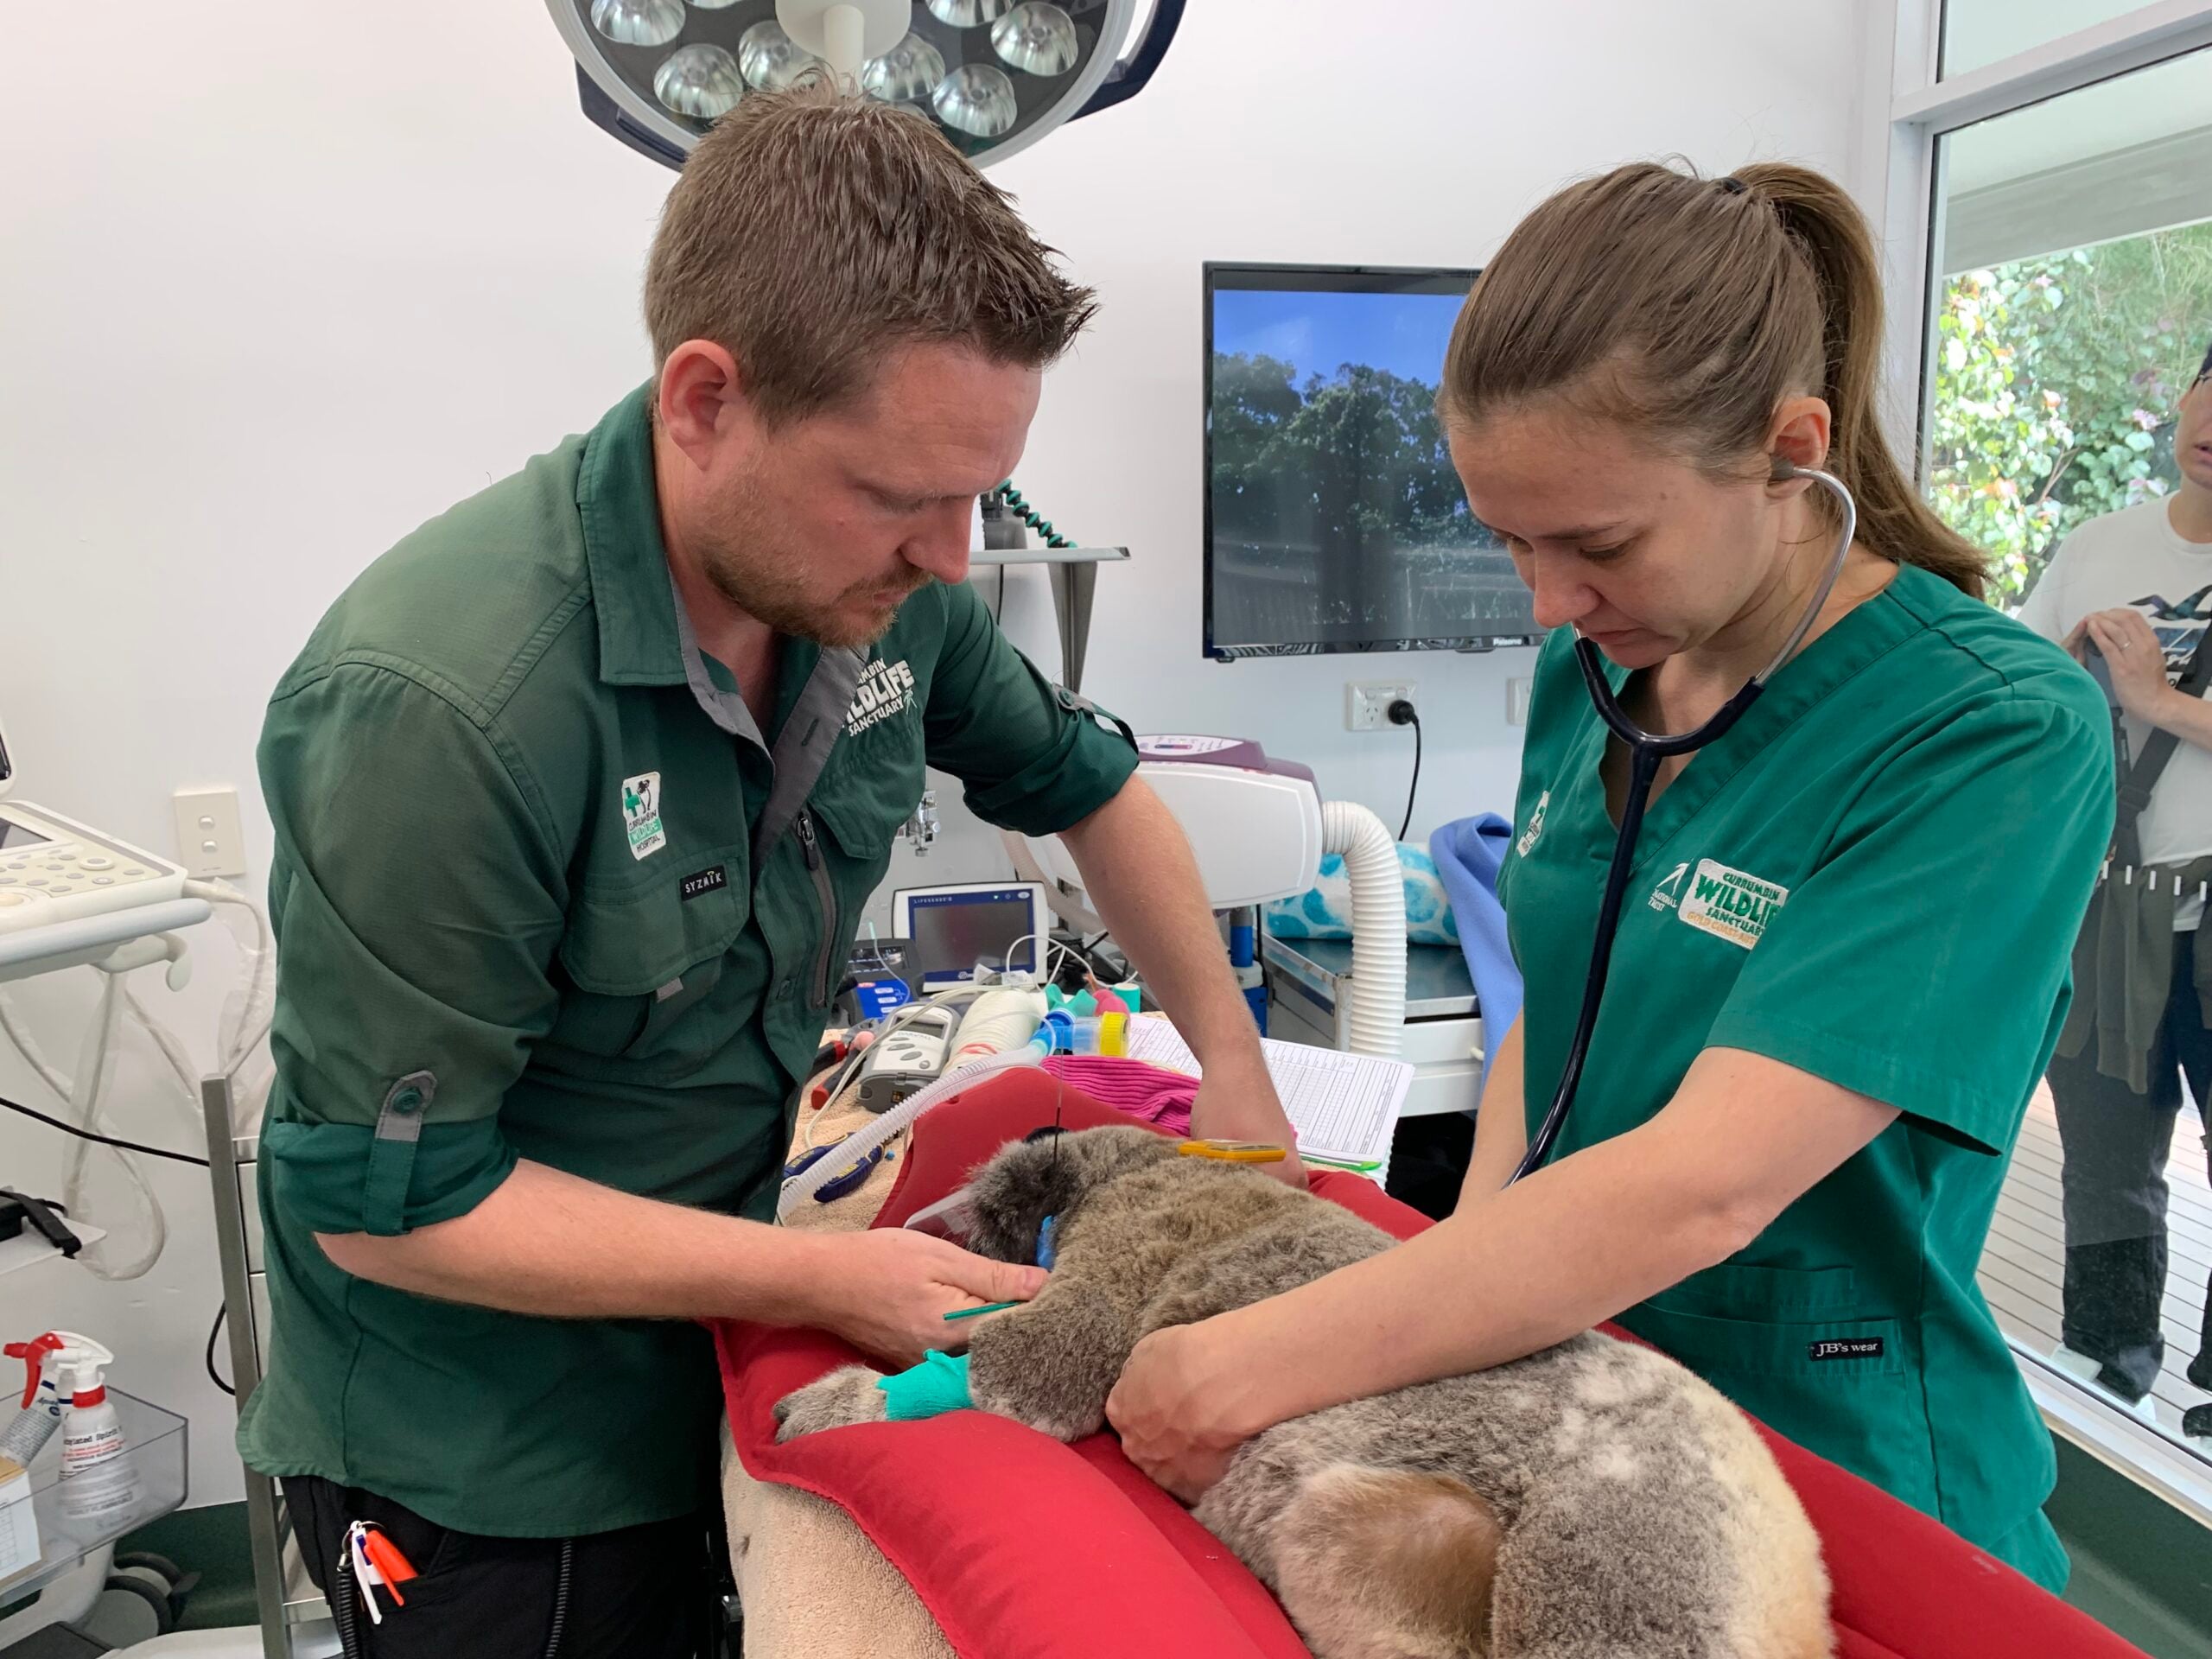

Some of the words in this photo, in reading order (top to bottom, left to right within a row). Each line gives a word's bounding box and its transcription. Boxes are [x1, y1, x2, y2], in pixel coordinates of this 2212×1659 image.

[848, 696, 905, 737] SANCTUARY
[636, 835, 661, 852] HOSPITAL
[685, 870, 722, 893] SYZMIK
[1722, 872, 1781, 901] CURRUMBIN
[1648, 897, 1665, 912] TRUST
[1652, 888, 1678, 908] NATIONAL
[1694, 873, 1781, 927] WILDLIF
[1686, 912, 1711, 927] GOLD
[1816, 1343, 1849, 1357] JB's
[1851, 1343, 1878, 1352] wear
